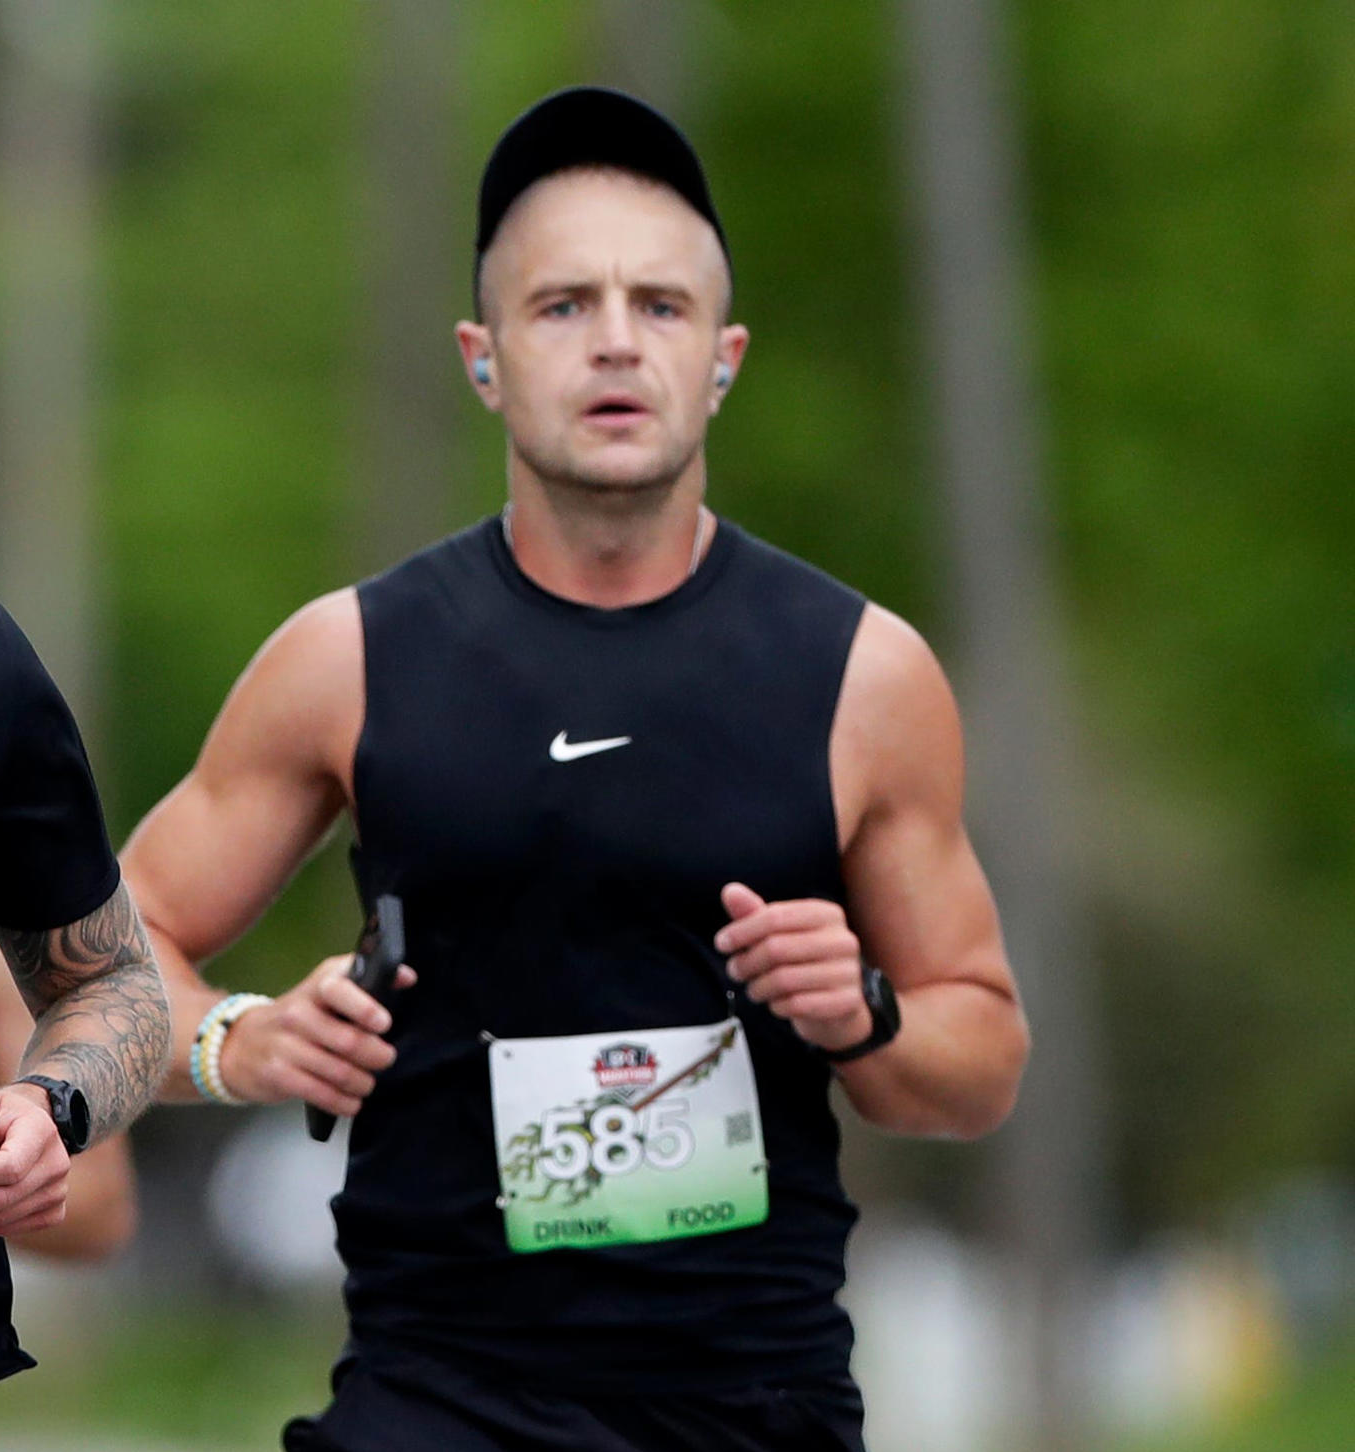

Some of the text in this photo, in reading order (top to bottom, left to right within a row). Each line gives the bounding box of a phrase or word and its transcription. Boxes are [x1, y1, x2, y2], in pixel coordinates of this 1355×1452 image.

[541, 1099, 696, 1180] 585
[534, 1201, 736, 1241] DRINK FOOD
